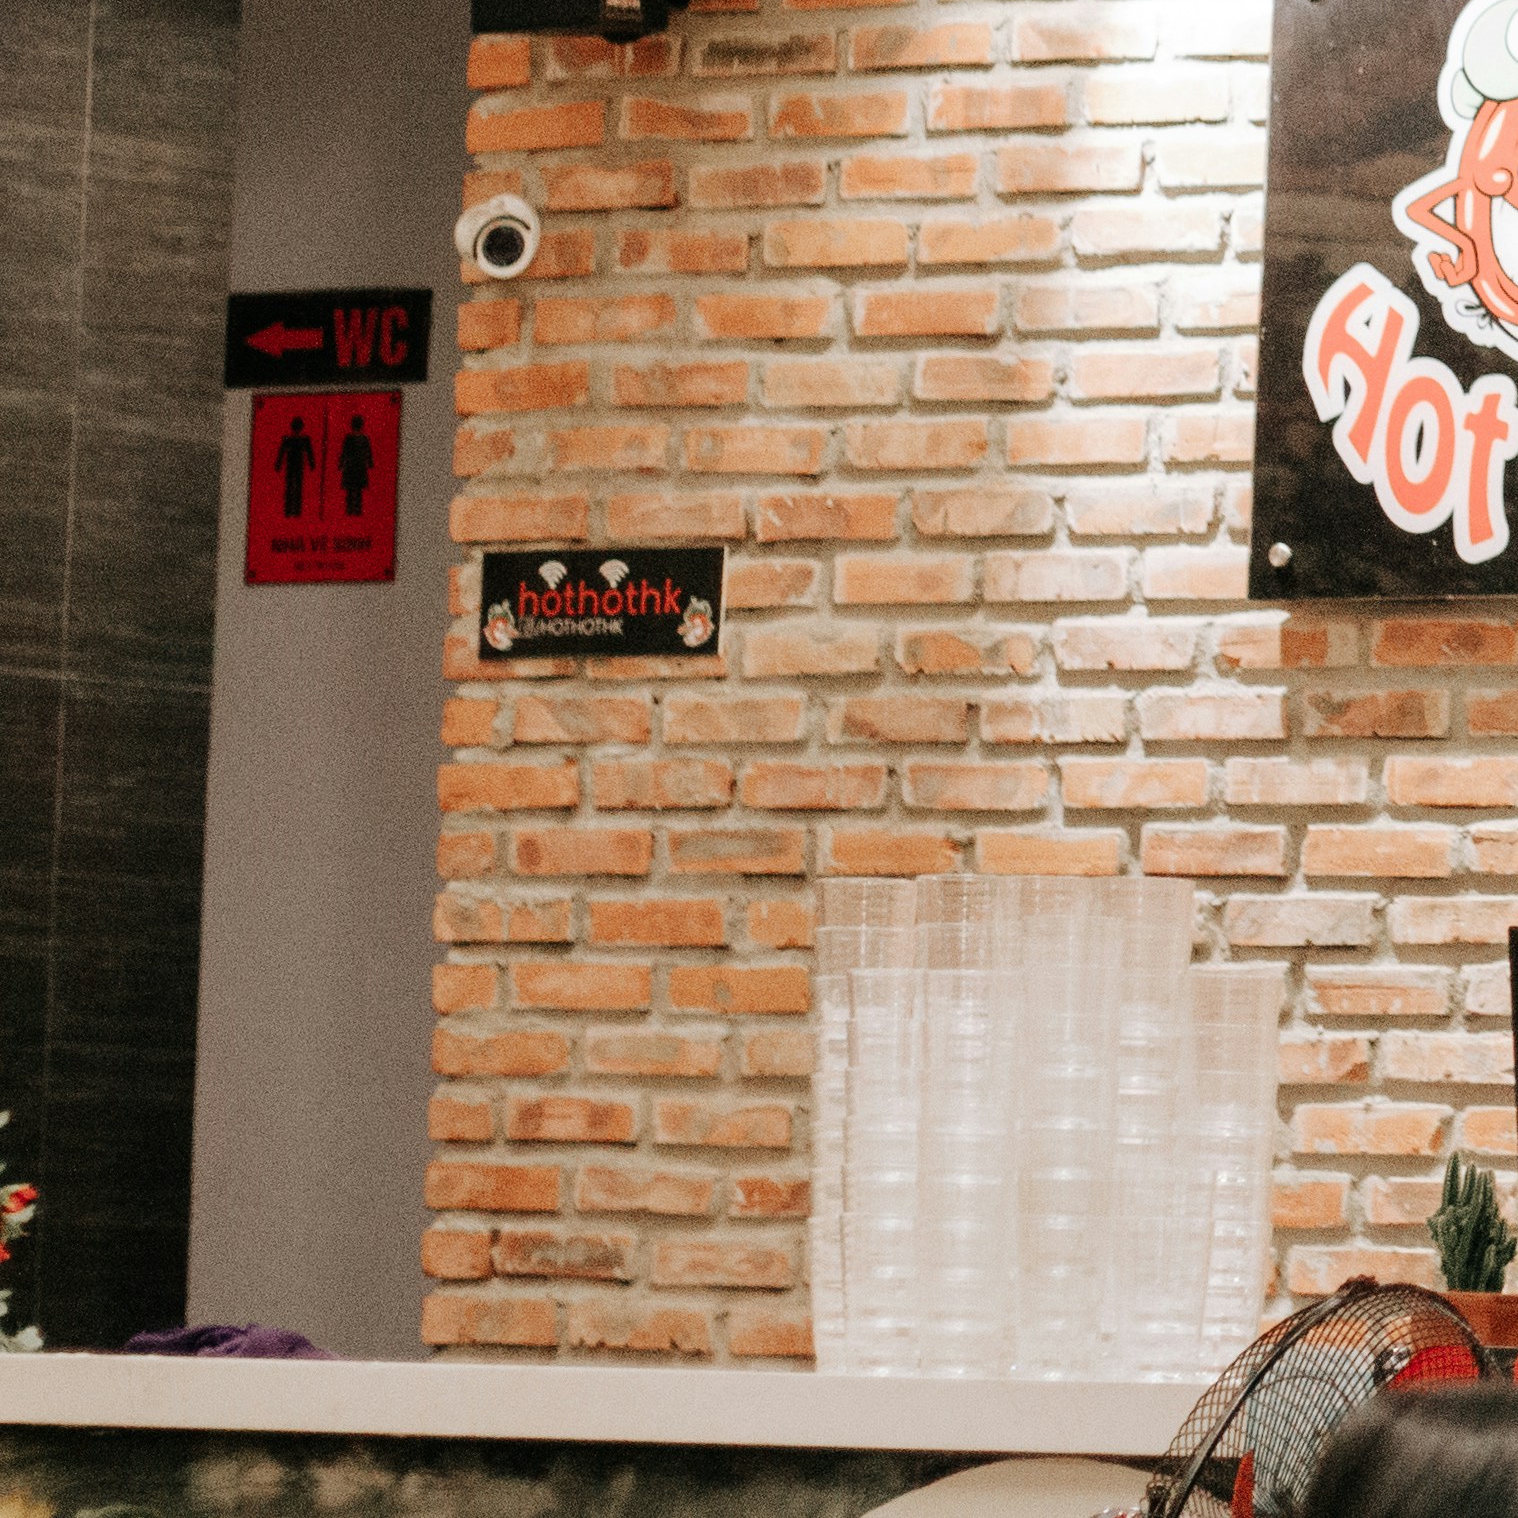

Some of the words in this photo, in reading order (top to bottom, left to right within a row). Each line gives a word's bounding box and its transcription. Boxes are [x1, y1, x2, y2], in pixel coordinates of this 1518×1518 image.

[333, 306, 408, 368] WC
[1309, 271, 1517, 557] Hot
[518, 578, 682, 617] hothothk
